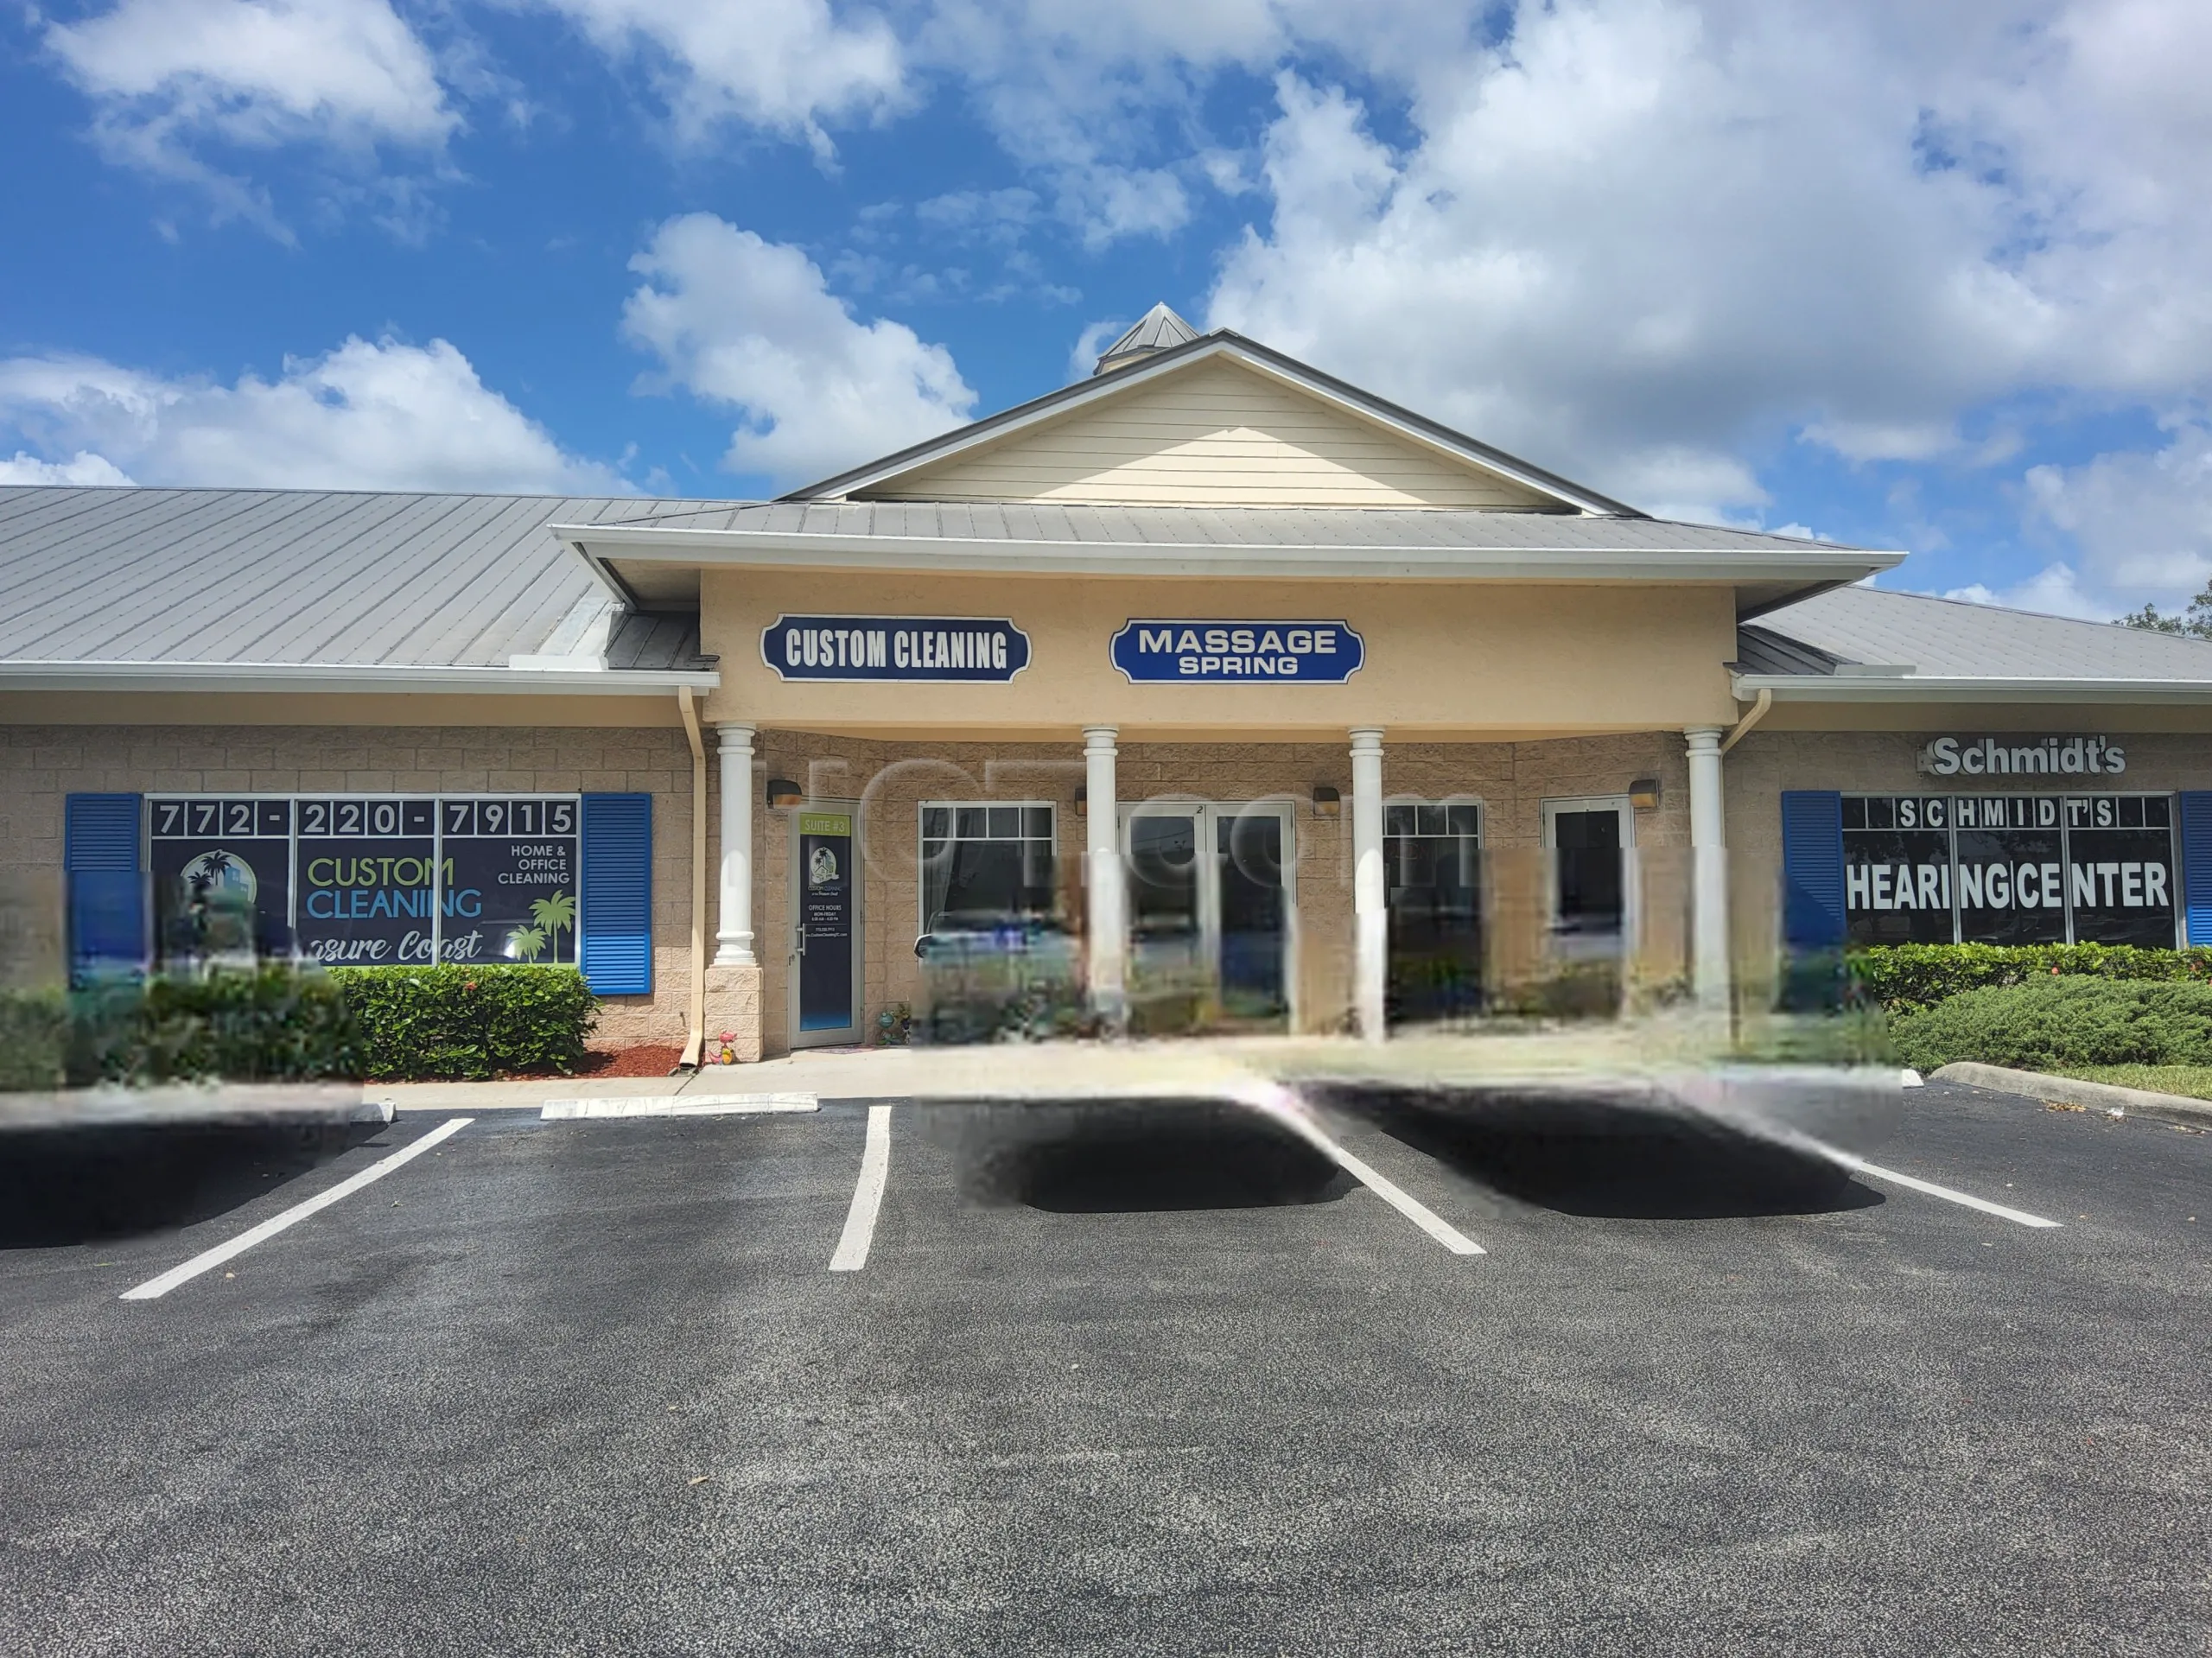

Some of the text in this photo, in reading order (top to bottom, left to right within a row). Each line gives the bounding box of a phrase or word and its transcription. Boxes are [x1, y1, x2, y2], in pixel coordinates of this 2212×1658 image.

[785, 630, 1007, 670] CUSTOM CLEANING
[1138, 629, 1338, 655] MASSAGE
[1178, 657, 1299, 676] SPRING
[1933, 735, 2126, 775] Schmidt's
[804, 819, 845, 833] SUITE #3
[1900, 798, 2113, 828] SCHMIDT'S
[511, 845, 566, 856] HOME &
[307, 857, 454, 886] CUSTOM
[518, 859, 567, 870] OFFICE
[498, 873, 570, 884] CLEANING
[306, 889, 482, 919] CLEANING
[397, 931, 484, 961] Coast
